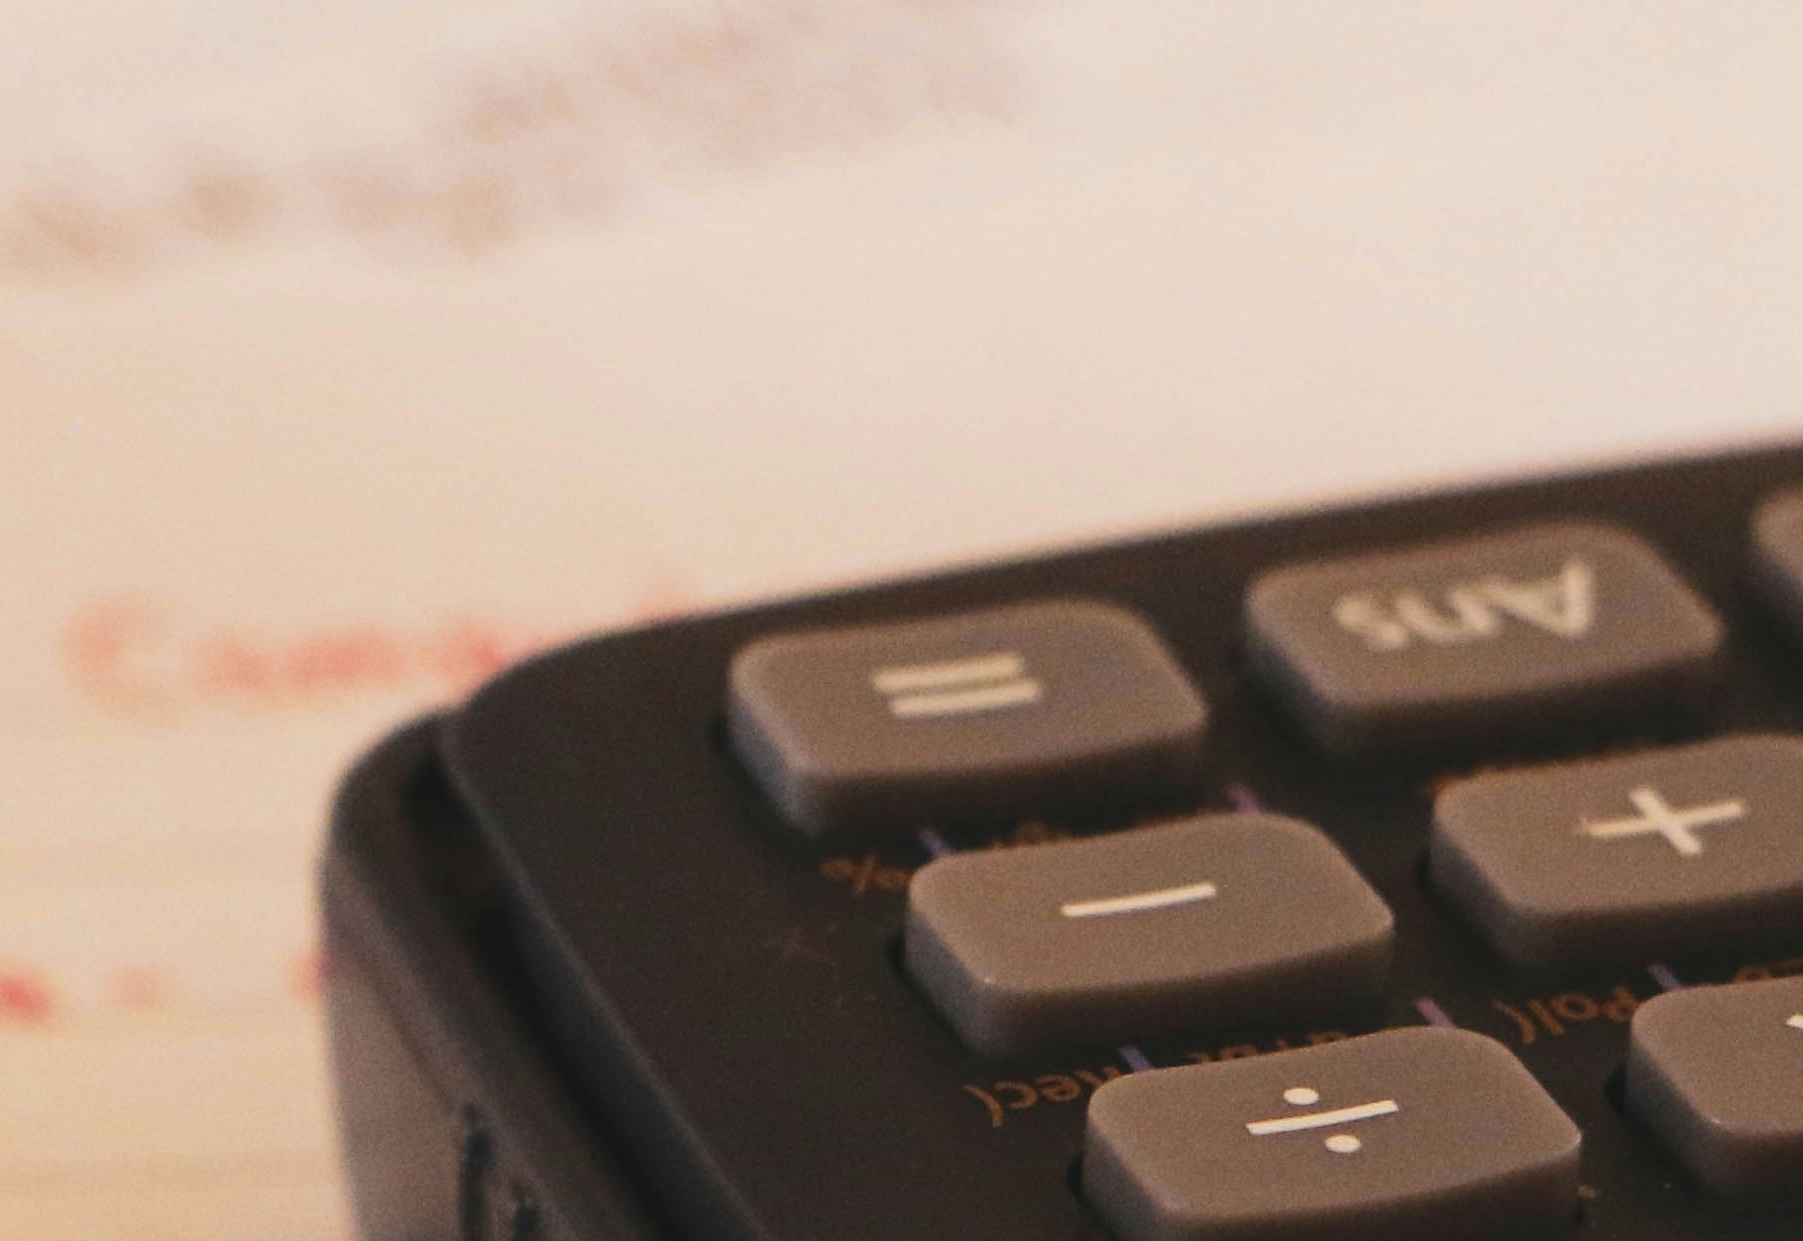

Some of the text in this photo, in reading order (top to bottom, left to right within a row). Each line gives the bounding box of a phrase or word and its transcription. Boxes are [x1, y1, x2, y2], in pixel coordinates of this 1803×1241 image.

[1335, 558, 1594, 652] Ans
[874, 652, 1042, 716] =
[1580, 786, 1749, 857] +
